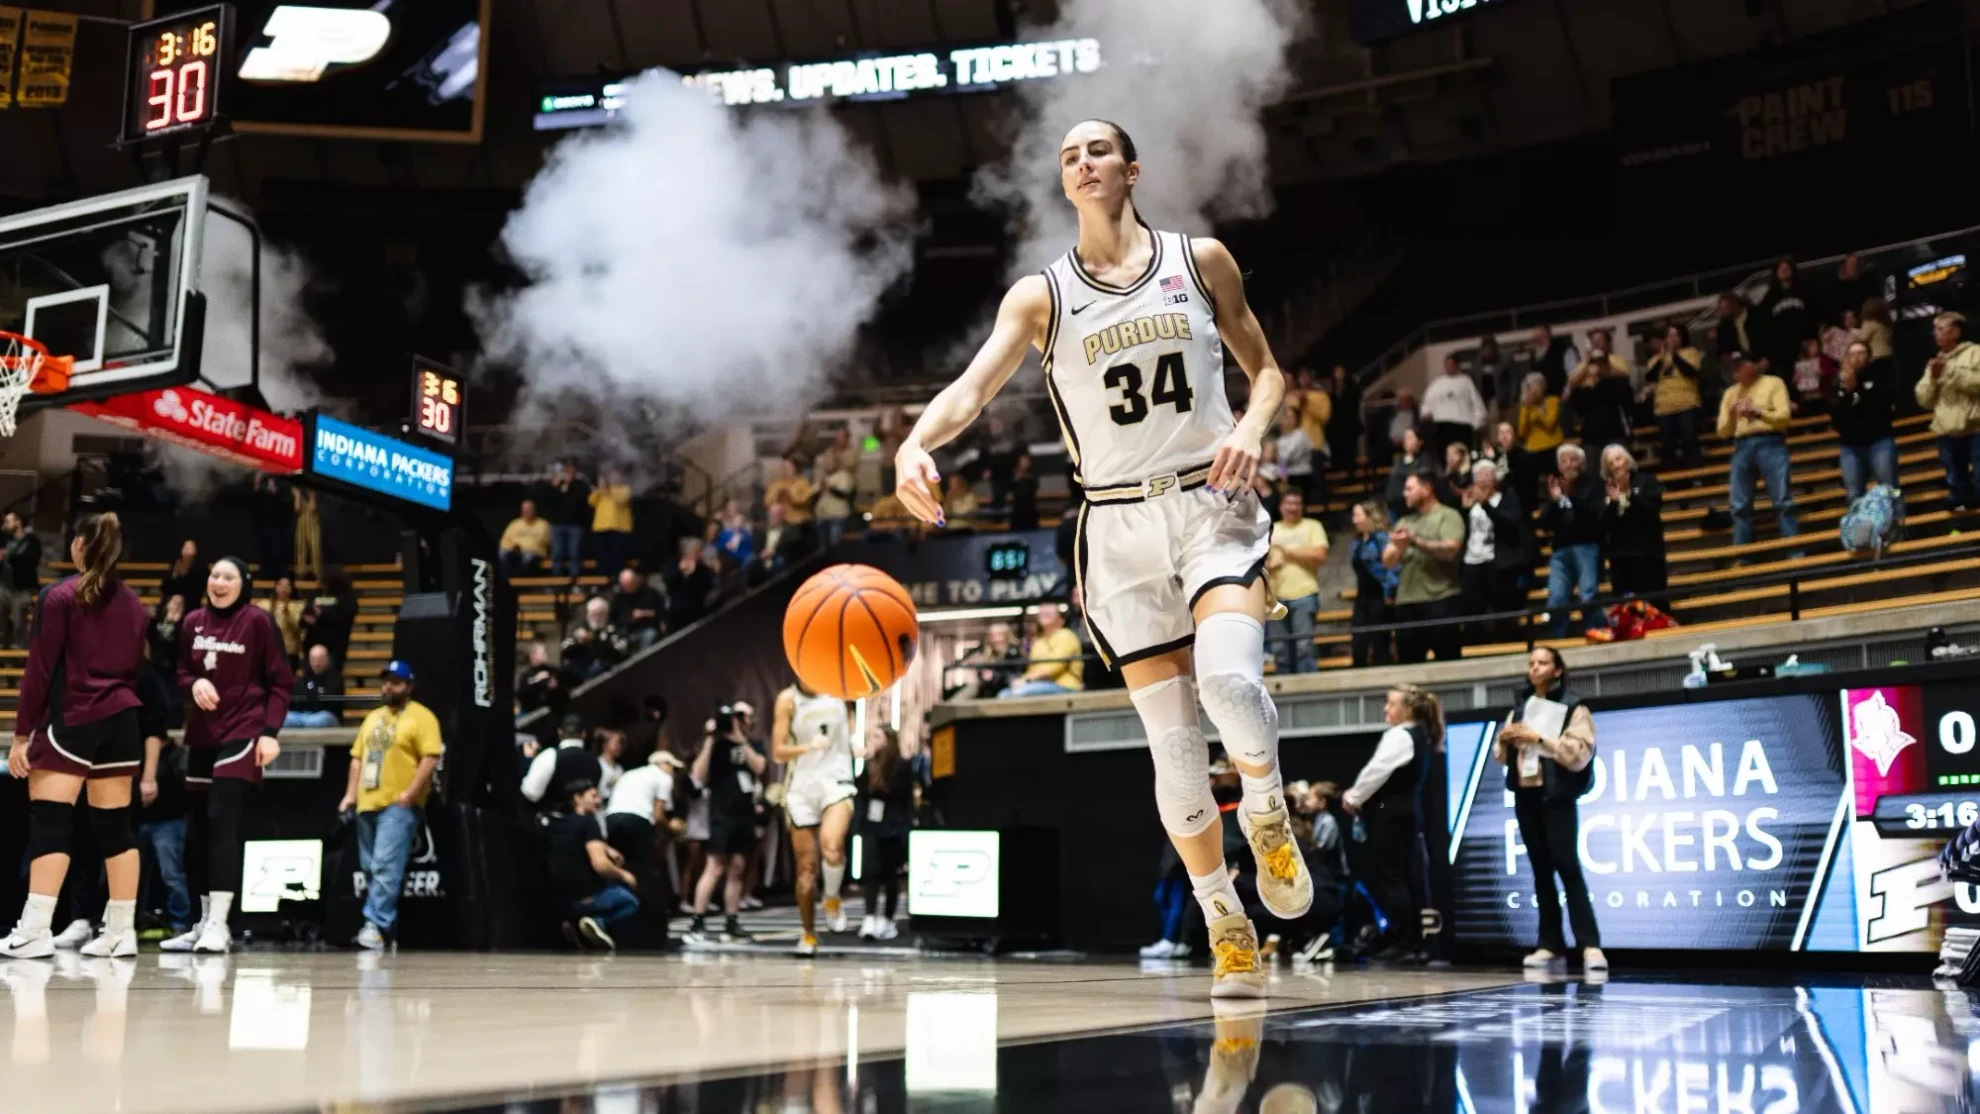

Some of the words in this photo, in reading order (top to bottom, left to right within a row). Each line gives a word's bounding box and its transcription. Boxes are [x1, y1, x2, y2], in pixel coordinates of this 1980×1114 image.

[159, 22, 216, 66] 3:16
[146, 61, 206, 129] 30
[682, 68, 785, 106] EWS.
[789, 53, 946, 99] UPDATES.
[1739, 76, 1844, 127] PAINT
[1743, 109, 1847, 159] CREW
[1083, 313, 1192, 366] PURDUE
[1103, 351, 1193, 426] 34
[422, 397, 450, 433] 30
[317, 449, 448, 498] CORPORATION
[318, 429, 388, 468] INDIANA
[391, 452, 450, 487] PACKERS
[1147, 475, 1176, 498] P
[947, 579, 984, 603] TO
[991, 573, 1059, 601] PLAY
[471, 557, 492, 708] ROHRMAN
[1938, 711, 1976, 754] 0
[1905, 801, 1979, 829] 3:16
[1504, 807, 1784, 876] PCKERS
